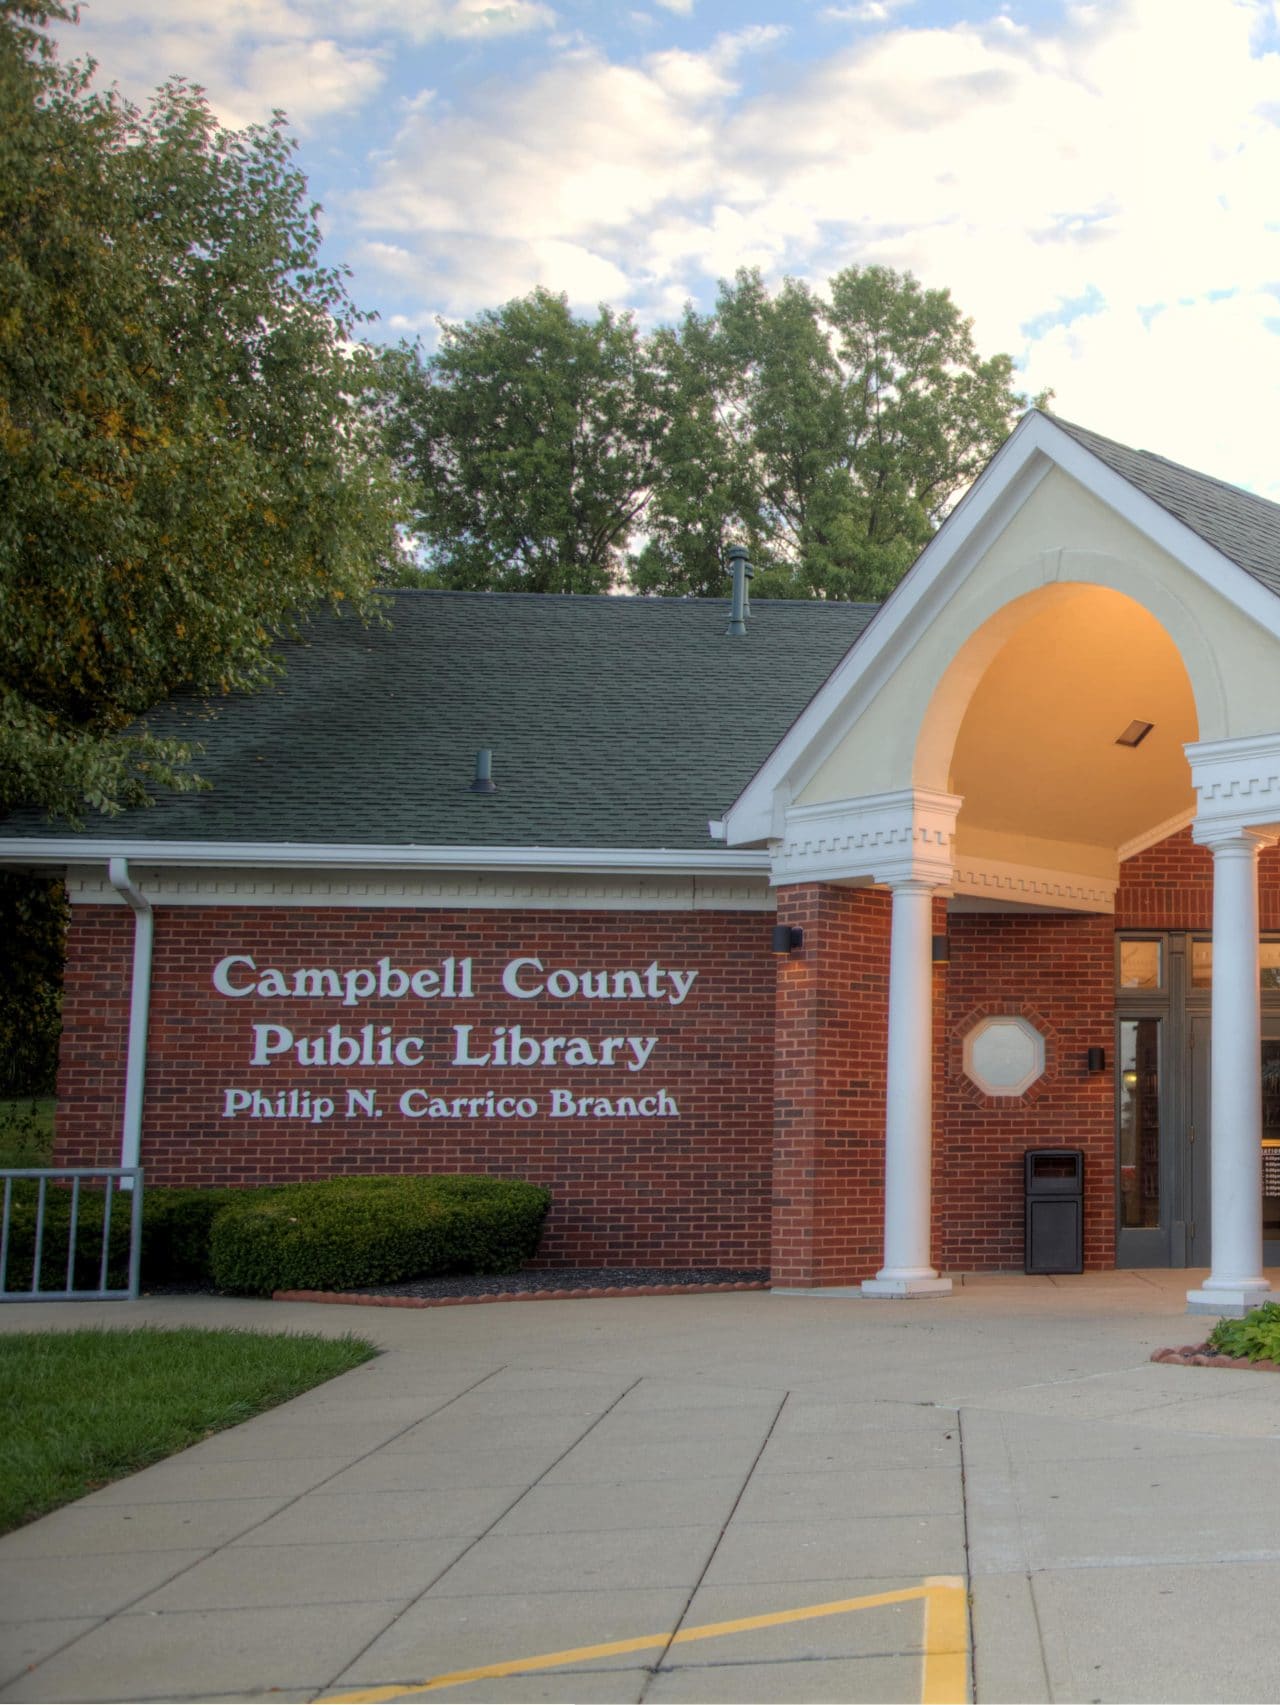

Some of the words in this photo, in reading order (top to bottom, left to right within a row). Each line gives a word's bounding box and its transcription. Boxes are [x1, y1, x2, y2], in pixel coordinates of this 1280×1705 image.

[213, 955, 475, 1006] Campbell
[502, 957, 699, 1005] County
[250, 1023, 425, 1066] Public
[451, 1024, 659, 1072] Library
[222, 1088, 335, 1123] Philip
[345, 1089, 383, 1117] N.
[400, 1088, 538, 1118] Carrico
[549, 1088, 680, 1118] Branch
